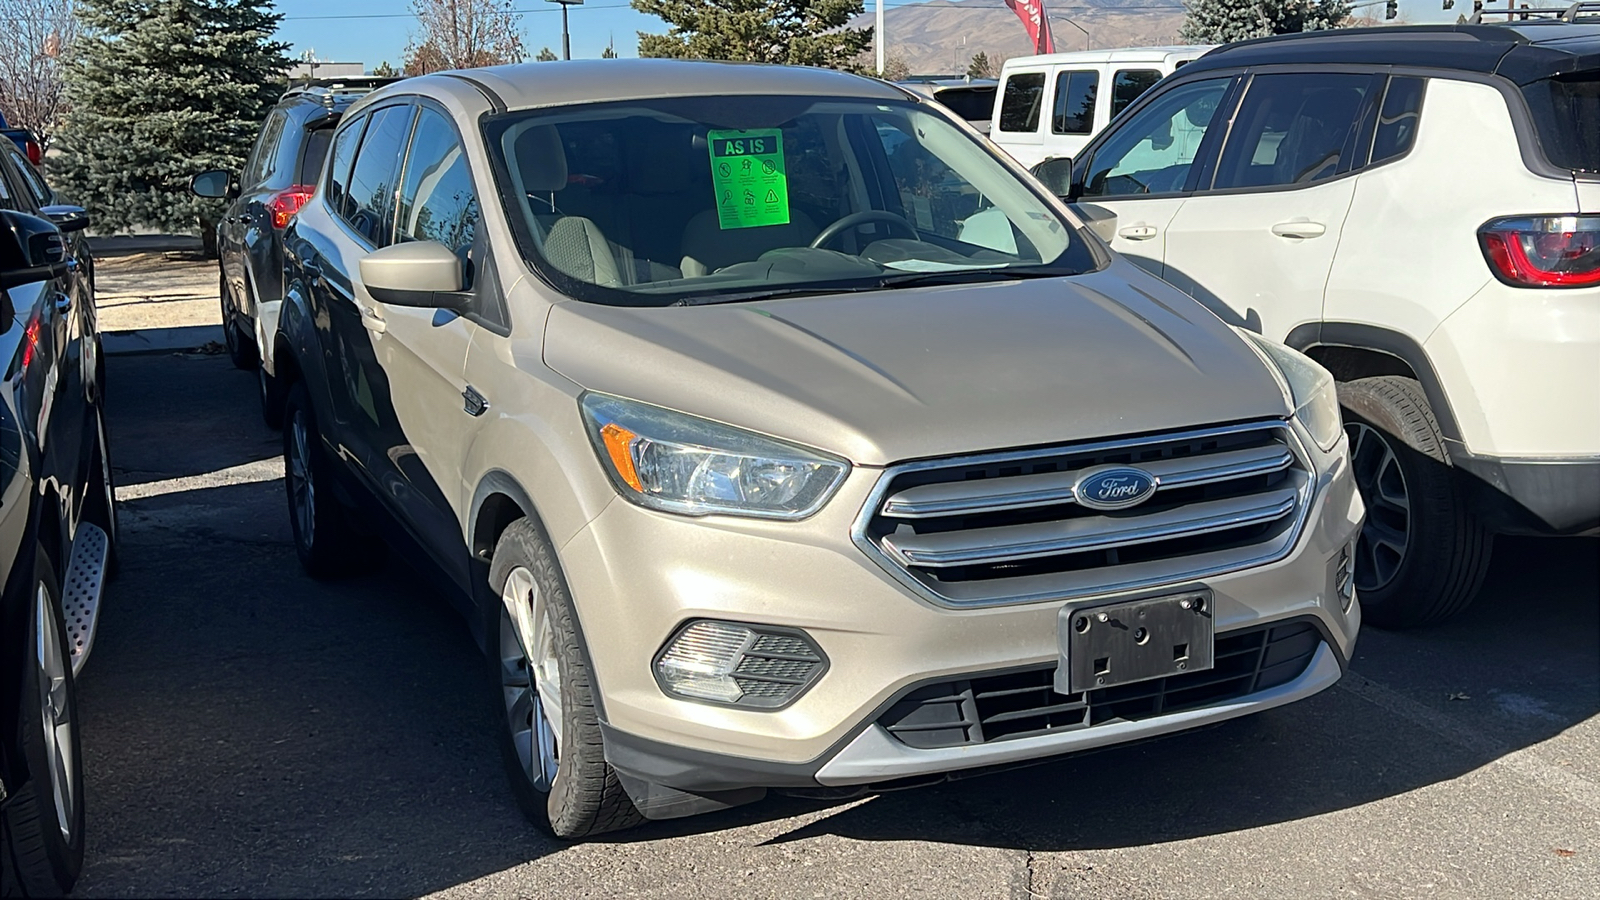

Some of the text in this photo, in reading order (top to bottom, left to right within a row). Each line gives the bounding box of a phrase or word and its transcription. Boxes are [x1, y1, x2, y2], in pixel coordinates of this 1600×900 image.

[725, 138, 765, 155] AS IS
[1098, 476, 1139, 499] Ford
